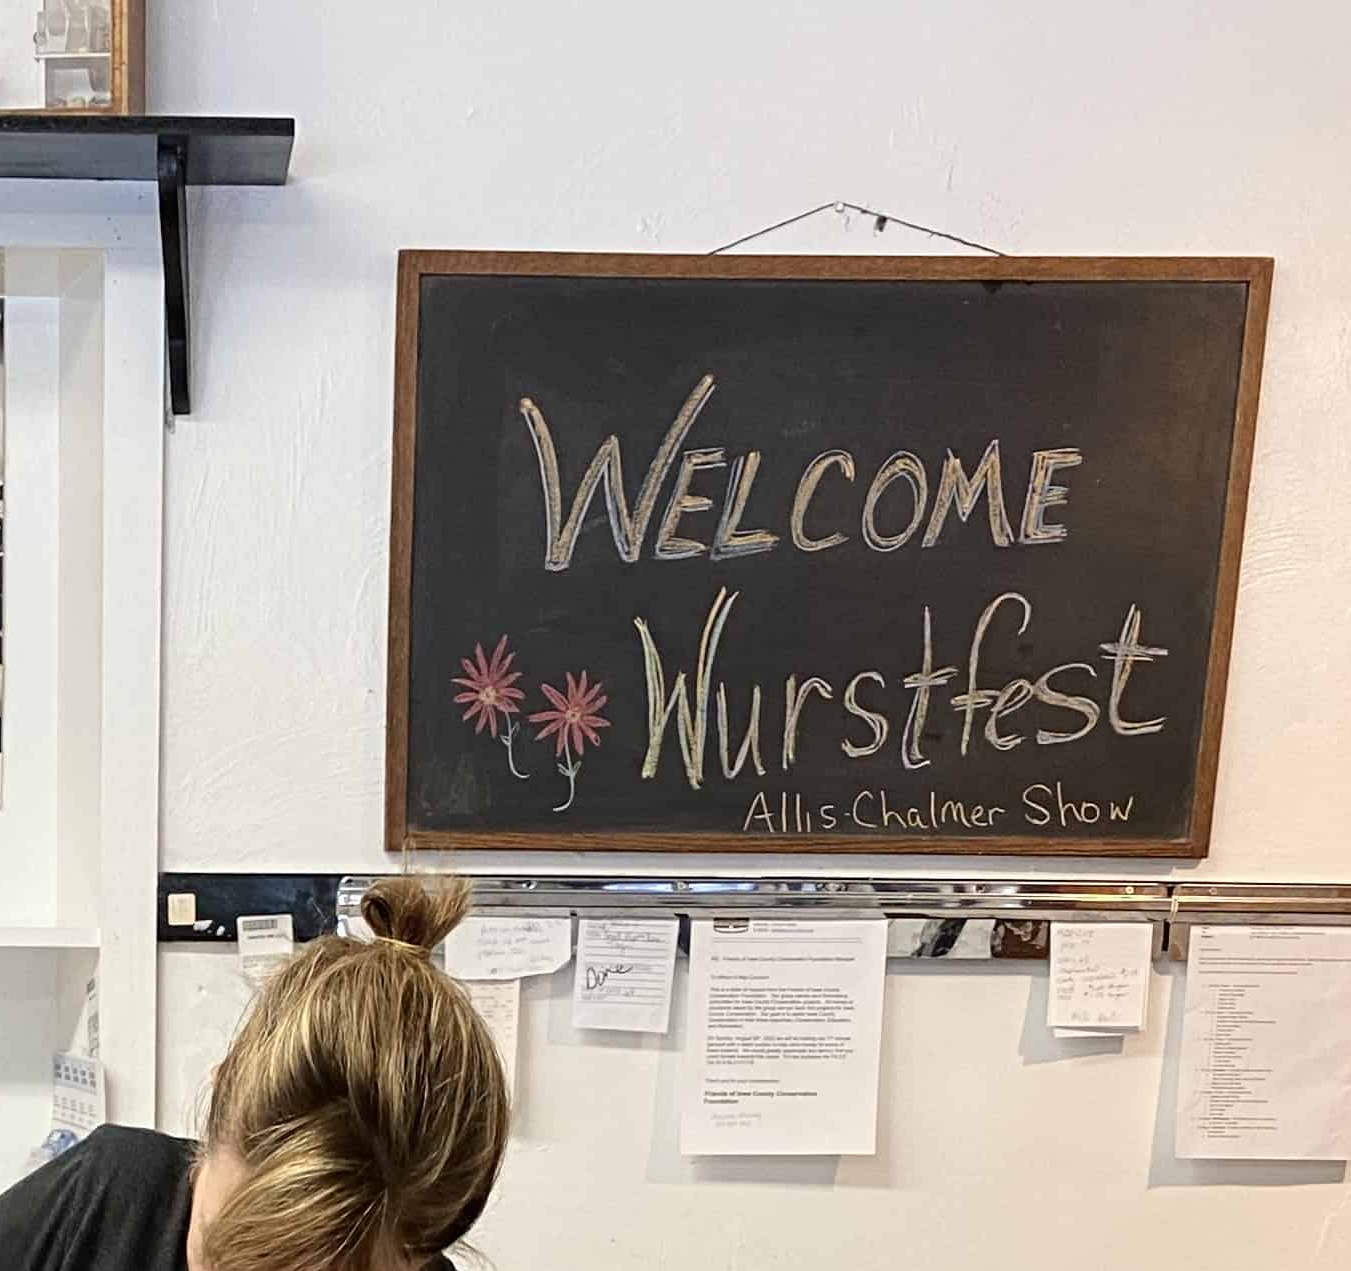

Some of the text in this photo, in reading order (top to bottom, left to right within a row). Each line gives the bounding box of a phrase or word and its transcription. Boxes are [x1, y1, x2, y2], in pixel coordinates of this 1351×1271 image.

[520, 375, 1082, 571] WELCOME
[633, 586, 1167, 790] Wurstfest
[1022, 782, 1134, 827] Show
